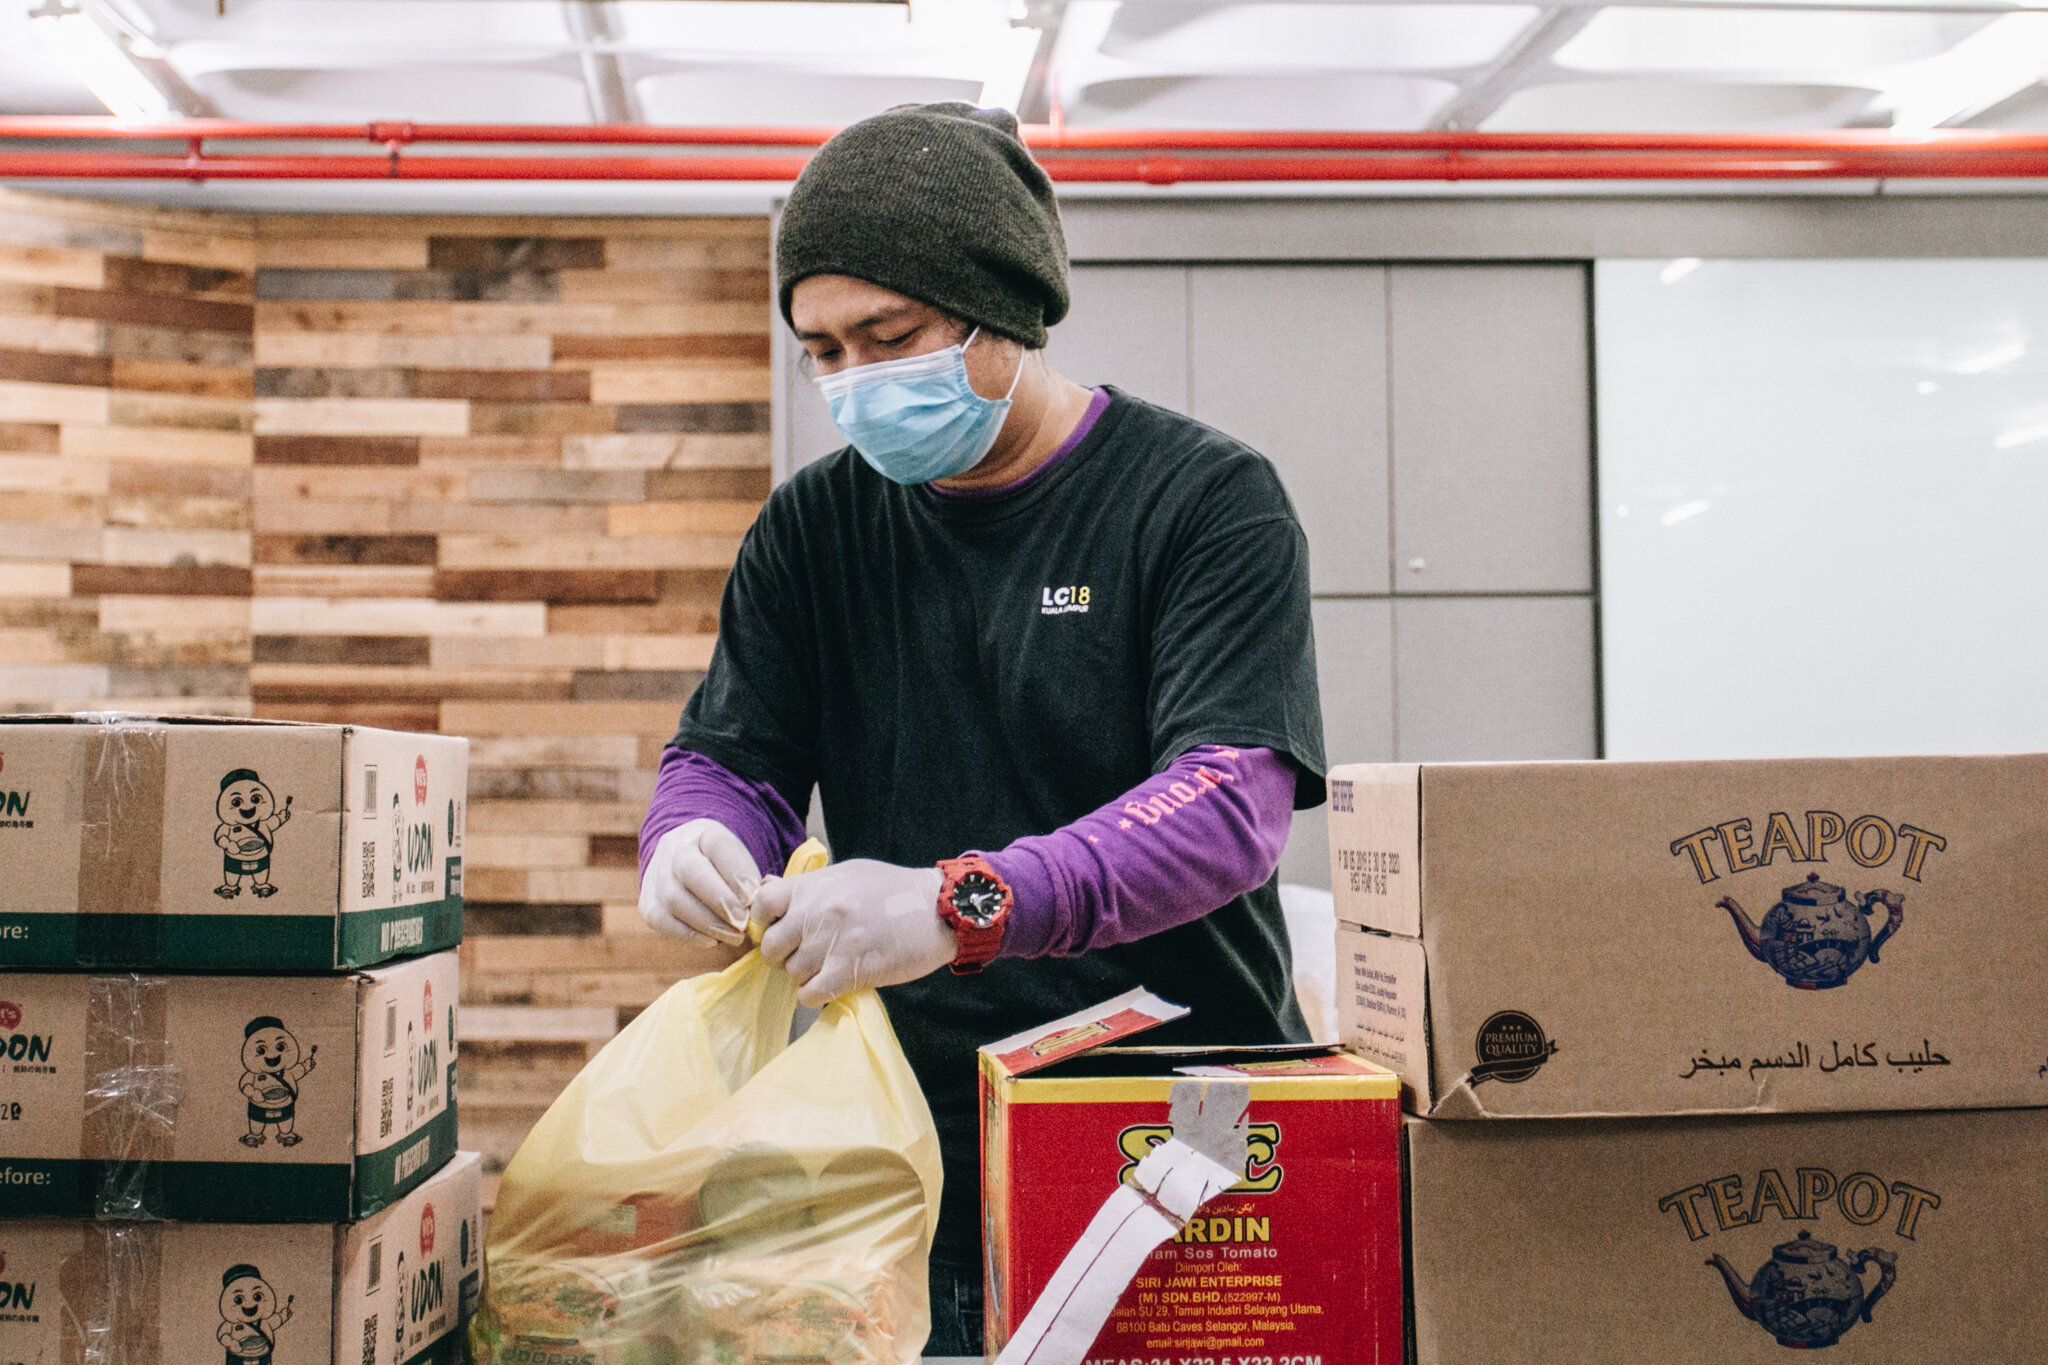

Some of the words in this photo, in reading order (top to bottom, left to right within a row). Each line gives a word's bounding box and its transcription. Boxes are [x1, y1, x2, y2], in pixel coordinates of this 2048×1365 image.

[1042, 586, 1090, 606] LC18
[407, 822, 434, 874] UDON
[1670, 810, 1947, 884] TEAPOT
[0, 926, 29, 939] re:
[1485, 1032, 1538, 1043] PREMIUM
[1485, 1043, 1538, 1056] QUALITY
[1820, 1040, 1879, 1073] كامل
[1886, 1039, 1951, 1074] حليب
[1679, 1049, 1742, 1079] مبخر
[1749, 1041, 1810, 1081] الدسم
[1658, 1167, 1942, 1241] TEAPOT
[1184, 1247, 1214, 1259] Sos
[1220, 1246, 1278, 1259] Tomato
[411, 1257, 445, 1324] UDON
[1135, 1277, 1161, 1289] SIRI
[1165, 1276, 1197, 1288] JAWI
[1200, 1275, 1283, 1288] ENTERPRISE
[1138, 1292, 1158, 1305] (M)
[1173, 1305, 1205, 1317] Taman
[1207, 1304, 1242, 1316] Industri
[1244, 1303, 1288, 1318] Selayang
[1116, 1321, 1146, 1333] 68100
[1148, 1321, 1171, 1333] Batu
[1172, 1320, 1203, 1332] Caves
